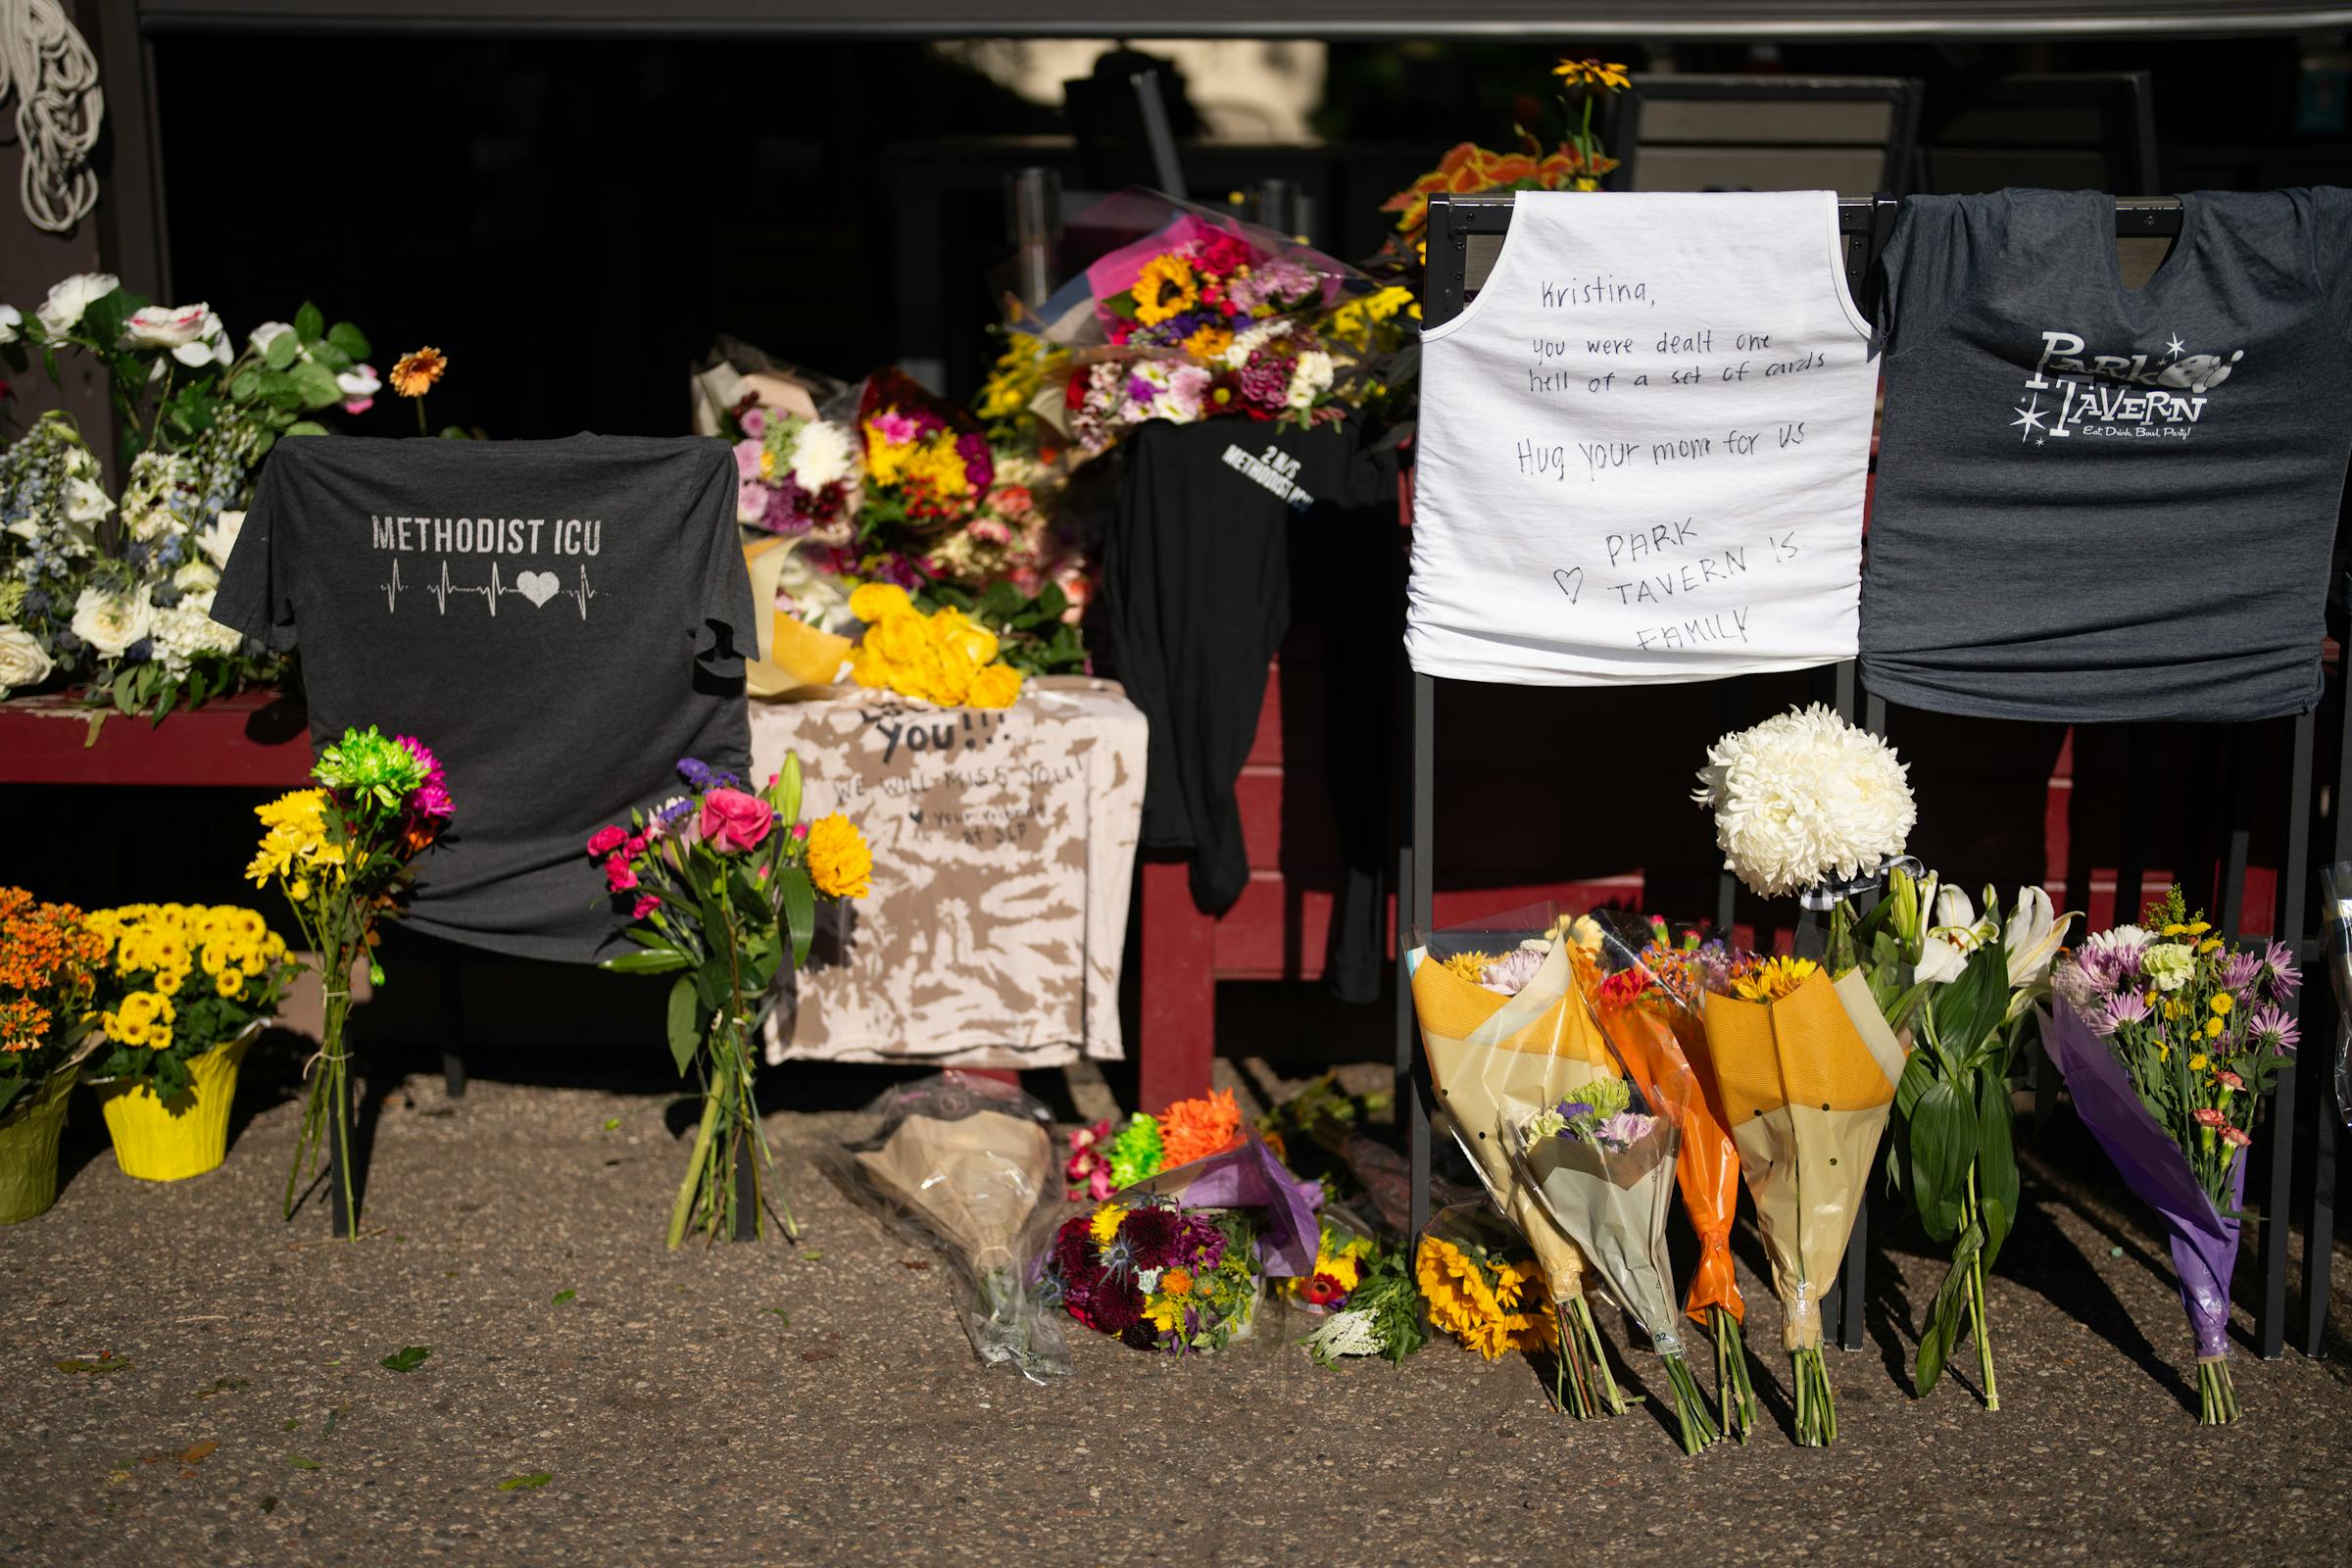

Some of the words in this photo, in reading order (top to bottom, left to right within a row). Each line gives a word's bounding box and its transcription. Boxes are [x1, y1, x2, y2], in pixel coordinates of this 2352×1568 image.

[1542, 274, 1655, 309] Kristina,
[1587, 338, 1633, 354] were
[1656, 329, 1713, 354] dealt
[1737, 331, 1771, 351] one
[1529, 368, 1568, 393] hell
[1589, 372, 1616, 393] of
[1634, 373, 1648, 387] a
[1671, 365, 1701, 385] set
[1722, 361, 1749, 382] of
[1765, 351, 1826, 378] cards
[1517, 438, 1564, 481] Hug
[1653, 439, 1710, 466] mom
[1723, 430, 1760, 456] for
[371, 515, 544, 554] METHODIST
[554, 519, 602, 556] ICU
[1606, 517, 1698, 567] PARK
[1607, 546, 1746, 605] TAVERN
[1769, 531, 1798, 564] IS
[1637, 607, 1748, 651] FAMILY
[880, 772, 931, 796] WILL
[944, 764, 1008, 790] MISS
